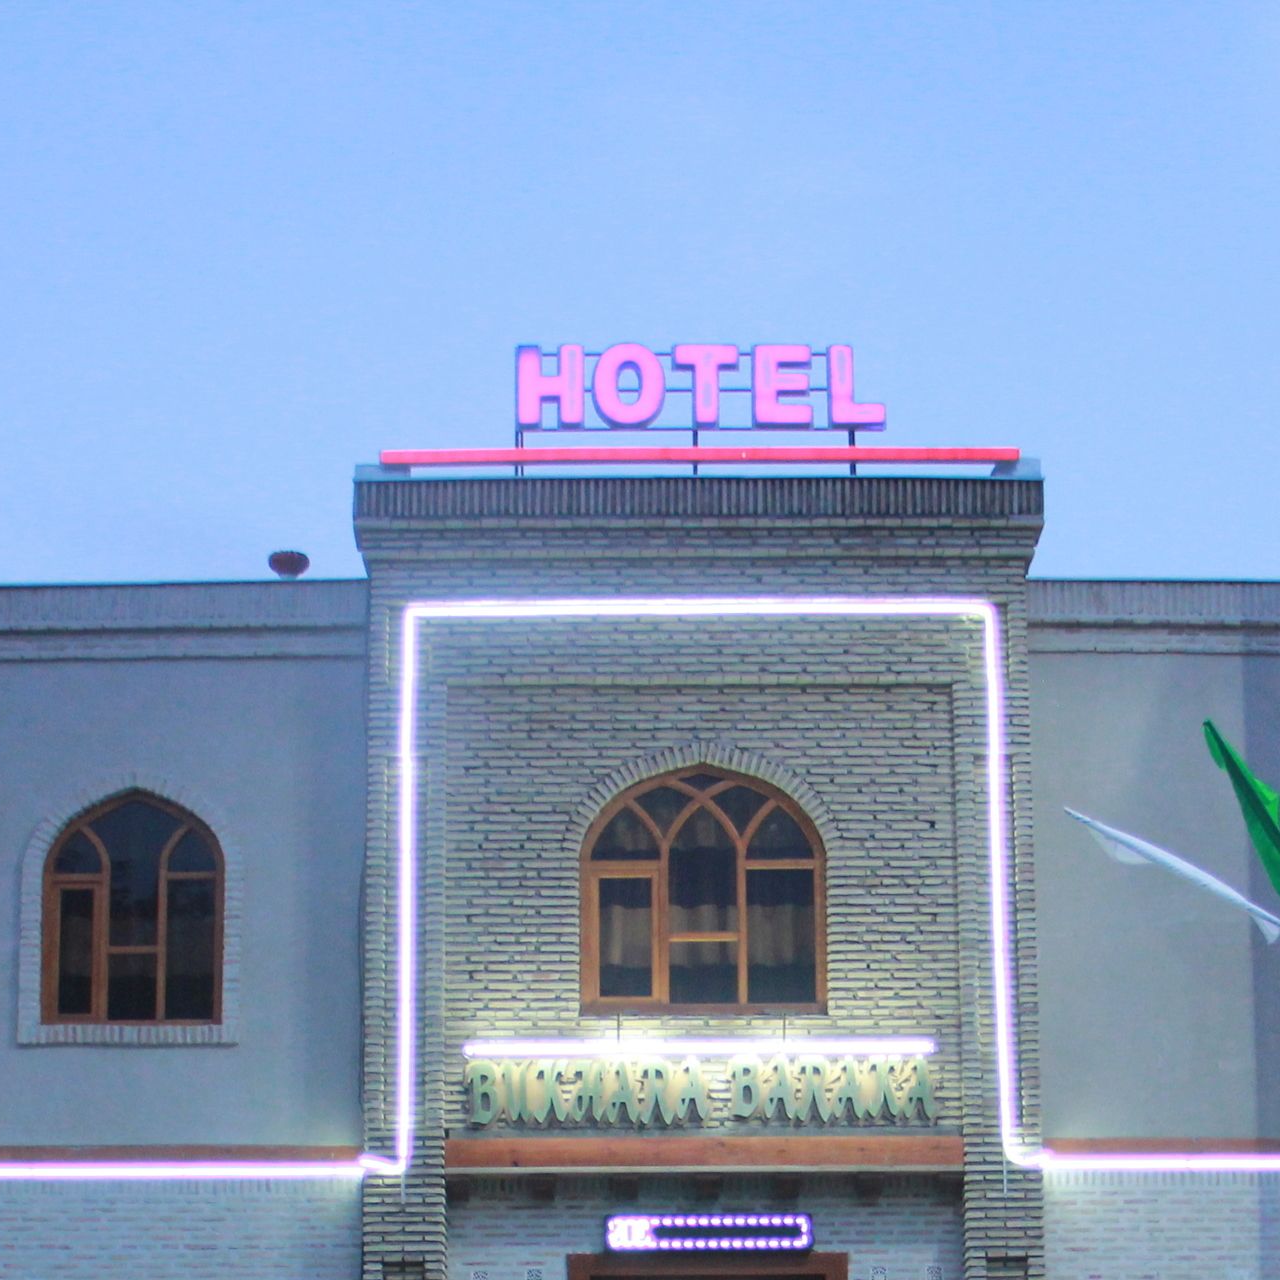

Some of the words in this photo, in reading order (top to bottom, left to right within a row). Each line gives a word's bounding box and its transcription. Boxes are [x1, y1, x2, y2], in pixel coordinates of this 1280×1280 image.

[516, 343, 887, 430] HOTEL
[466, 1058, 710, 1126] BUKHARA
[729, 1055, 937, 1126] BARAKA
